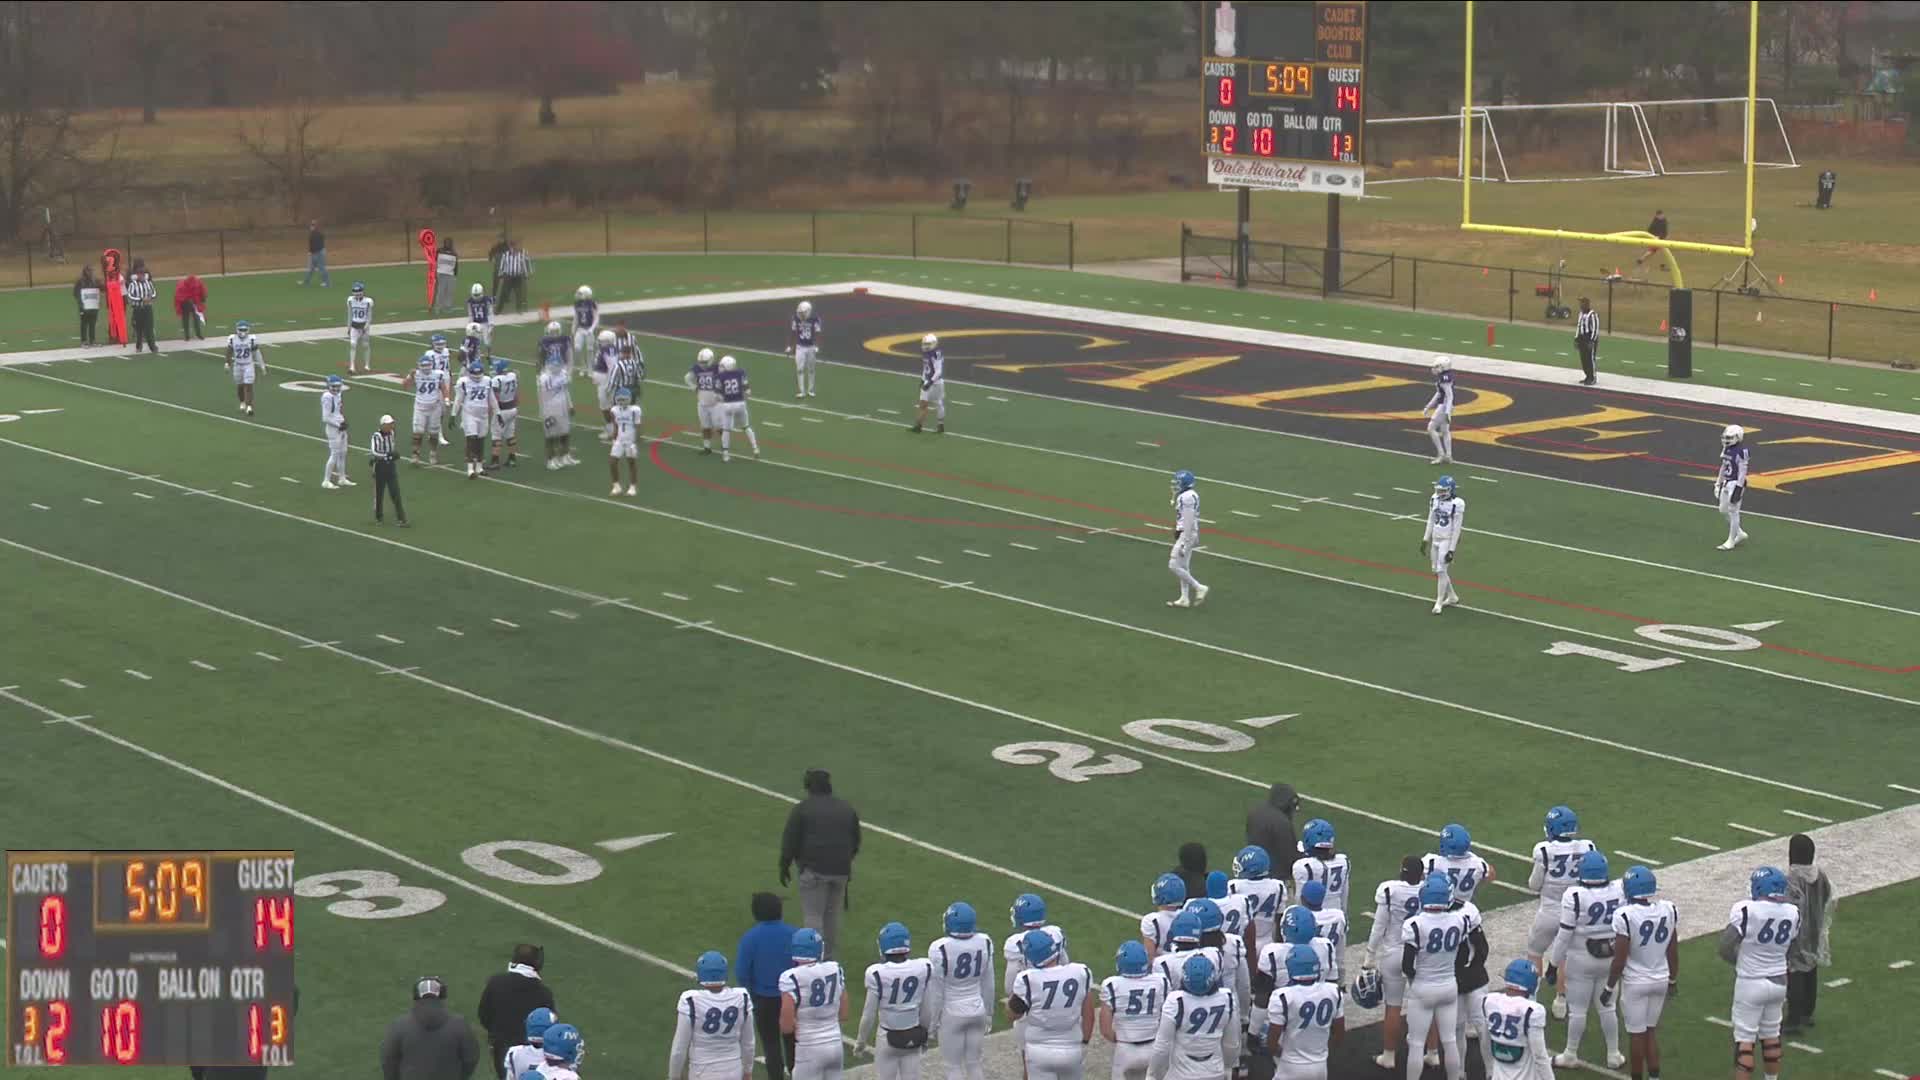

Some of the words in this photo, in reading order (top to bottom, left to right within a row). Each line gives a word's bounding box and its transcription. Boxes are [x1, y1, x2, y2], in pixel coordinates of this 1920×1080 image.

[1324, 8, 1356, 22] CADET
[1204, 63, 1235, 77] CADETS
[1266, 64, 1309, 93] 5:09
[1328, 69, 1360, 83] GUEST
[1220, 77, 1234, 106] 0
[1337, 86, 1360, 111] 14
[1208, 110, 1236, 125] DOWN
[1246, 112, 1260, 127] GO
[1261, 113, 1273, 128] TO
[1284, 114, 1307, 130] BALL
[1307, 116, 1318, 131] ON
[1323, 117, 1342, 132] QTR
[1222, 126, 1236, 154] 2
[1253, 128, 1274, 156] 10
[1211, 159, 1248, 176] Dale
[1247, 160, 1306, 181] Howard
[418, 381, 436, 394] 69
[1541, 624, 1763, 673] 10
[991, 718, 1256, 783] 20
[294, 840, 604, 919] 30
[1425, 926, 1460, 954] 80
[1638, 916, 1669, 948] 96
[1757, 918, 1793, 945] 68
[953, 949, 983, 980] 81
[809, 972, 838, 1007] 87
[888, 975, 920, 1005] 19
[1041, 978, 1080, 1011] 79
[1125, 988, 1157, 1016] 51
[702, 1006, 740, 1035] 89
[1186, 1005, 1227, 1035] 97
[1299, 998, 1334, 1030] 90
[1488, 1011, 1522, 1040] 25
